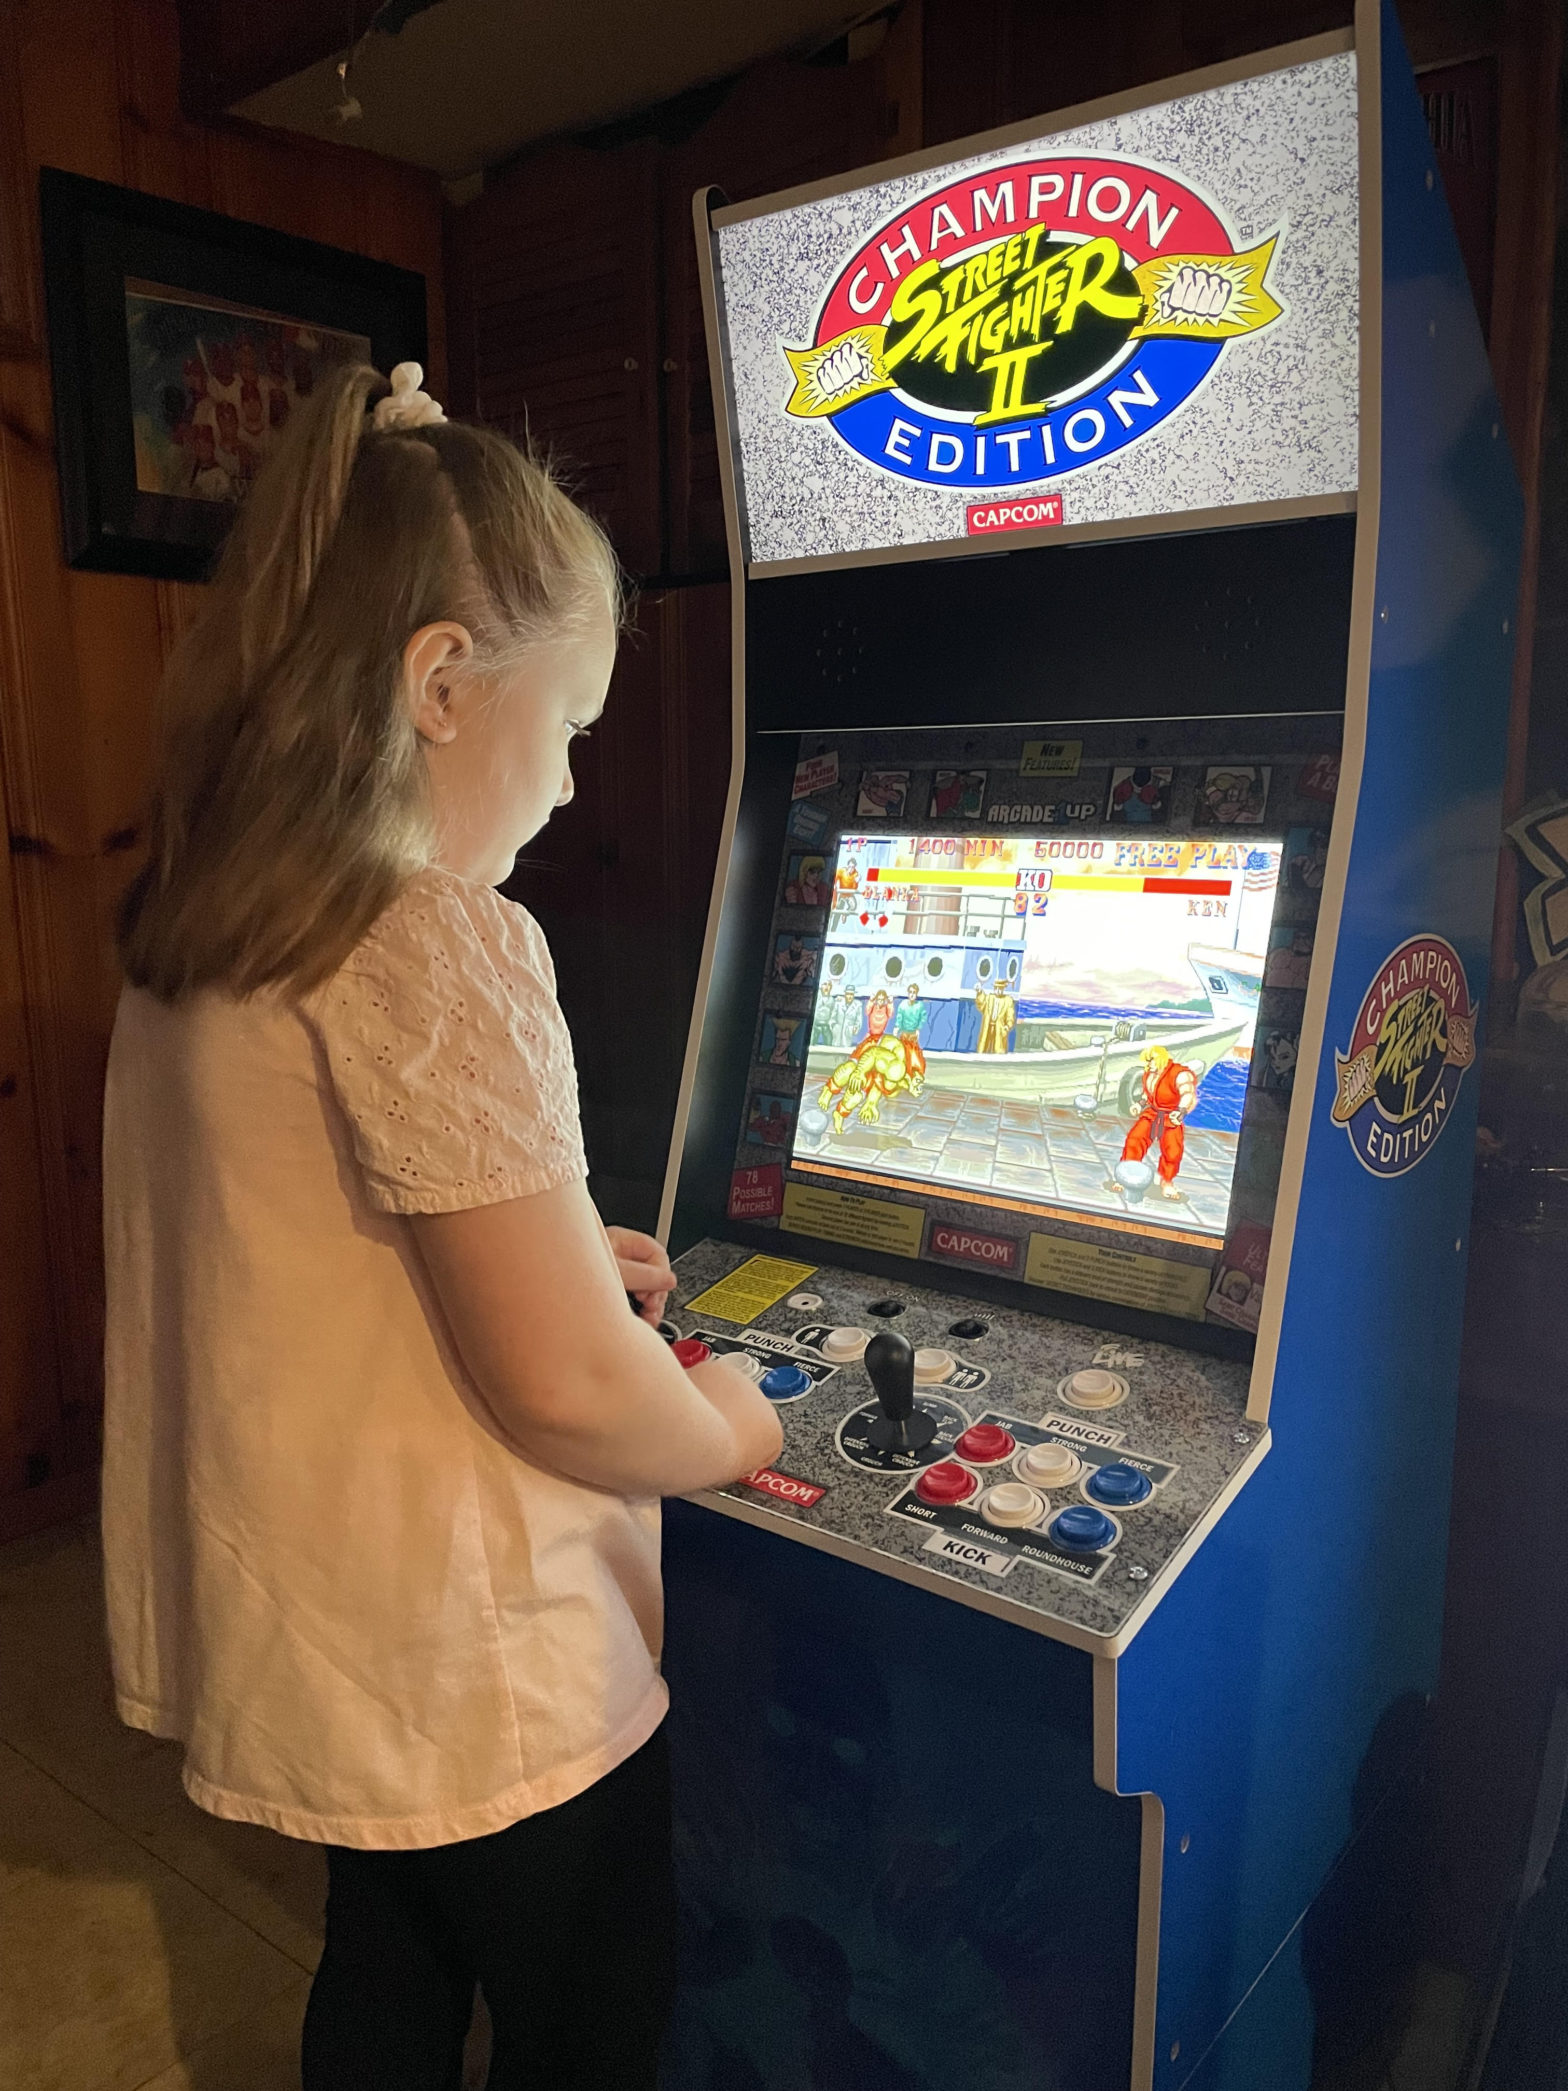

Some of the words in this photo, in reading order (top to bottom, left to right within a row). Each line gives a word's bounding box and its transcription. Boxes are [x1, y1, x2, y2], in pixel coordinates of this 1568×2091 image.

[848, 173, 1180, 313] CHAMPION
[878, 222, 1047, 374] STREET
[912, 236, 1145, 373] FIGHTER
[973, 341, 1053, 425] II
[884, 369, 1160, 475] EDITION
[846, 838, 867, 852] 1P
[909, 838, 956, 855] 1400
[1035, 841, 1104, 859] 50000
[1114, 842, 1181, 868] FREE
[1190, 843, 1258, 870] PLAY
[1017, 869, 1051, 891] KO
[1014, 893, 1049, 916] 82
[1188, 899, 1228, 917] KEN
[1366, 951, 1461, 1035] CHAMPION
[1373, 983, 1430, 1082] STREET
[1385, 998, 1448, 1085] FIGHTER
[1398, 1065, 1425, 1124] II
[1366, 1087, 1448, 1164] EDITION
[746, 1171, 758, 1184] 78
[733, 1186, 773, 1199] POSSIBLE
[731, 1200, 775, 1214] MATCHES!
[742, 1347, 772, 1359] STRONG
[744, 1334, 794, 1352] PUNCH
[793, 1361, 821, 1373] FIERCE
[995, 1420, 1013, 1430] JAB
[1046, 1420, 1114, 1445] PUNCH
[1050, 1437, 1088, 1452] STRONG
[1118, 1457, 1155, 1472] FIERCE
[740, 1470, 814, 1501] APCOM
[905, 1504, 937, 1520] SHORT
[961, 1523, 1009, 1544] FORWARD
[943, 1540, 993, 1566] KICK
[1022, 1545, 1094, 1575] ROUNDHOUSE
